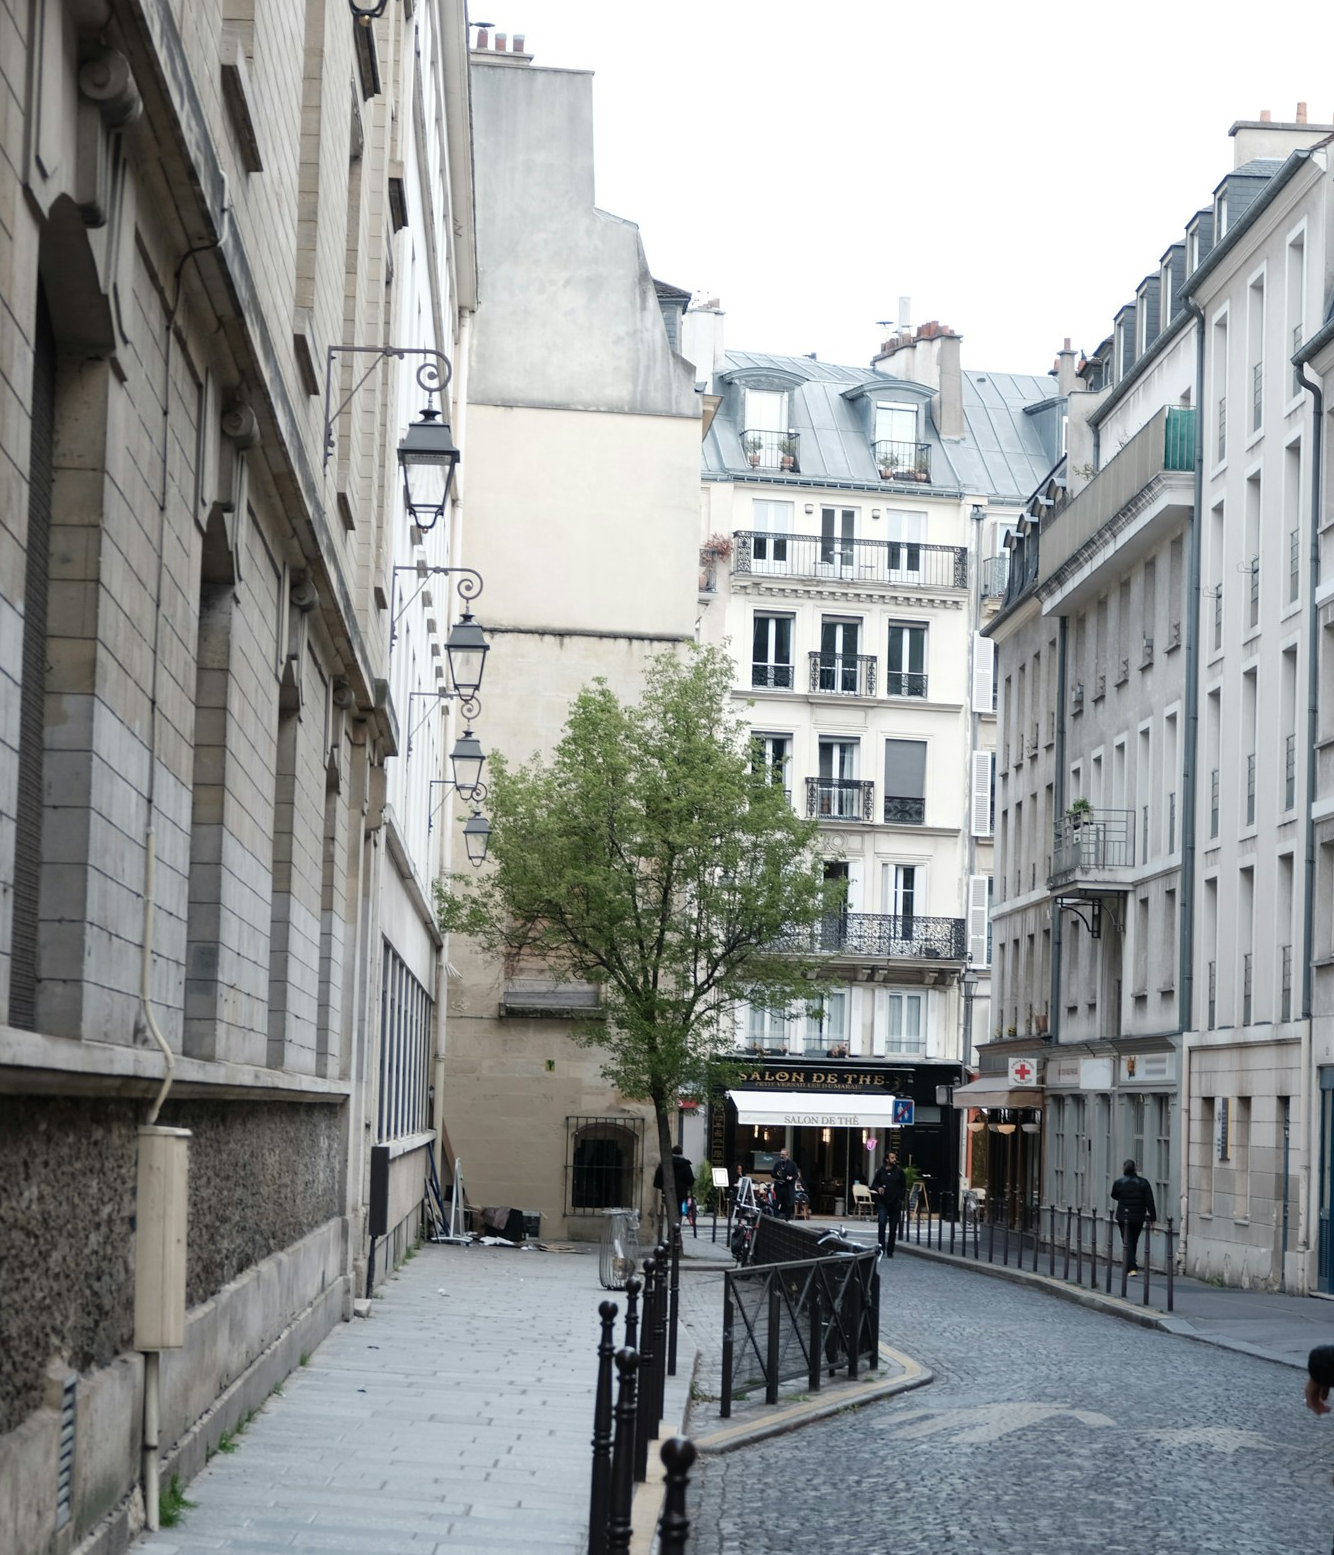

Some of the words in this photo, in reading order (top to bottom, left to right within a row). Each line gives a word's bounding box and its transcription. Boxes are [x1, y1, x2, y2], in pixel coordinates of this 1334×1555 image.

[738, 1071, 805, 1083] SALON
[812, 1072, 838, 1084] DE
[784, 1115, 819, 1124] SALON
[821, 1116, 836, 1125] DE
[838, 1115, 860, 1125] THÉ
